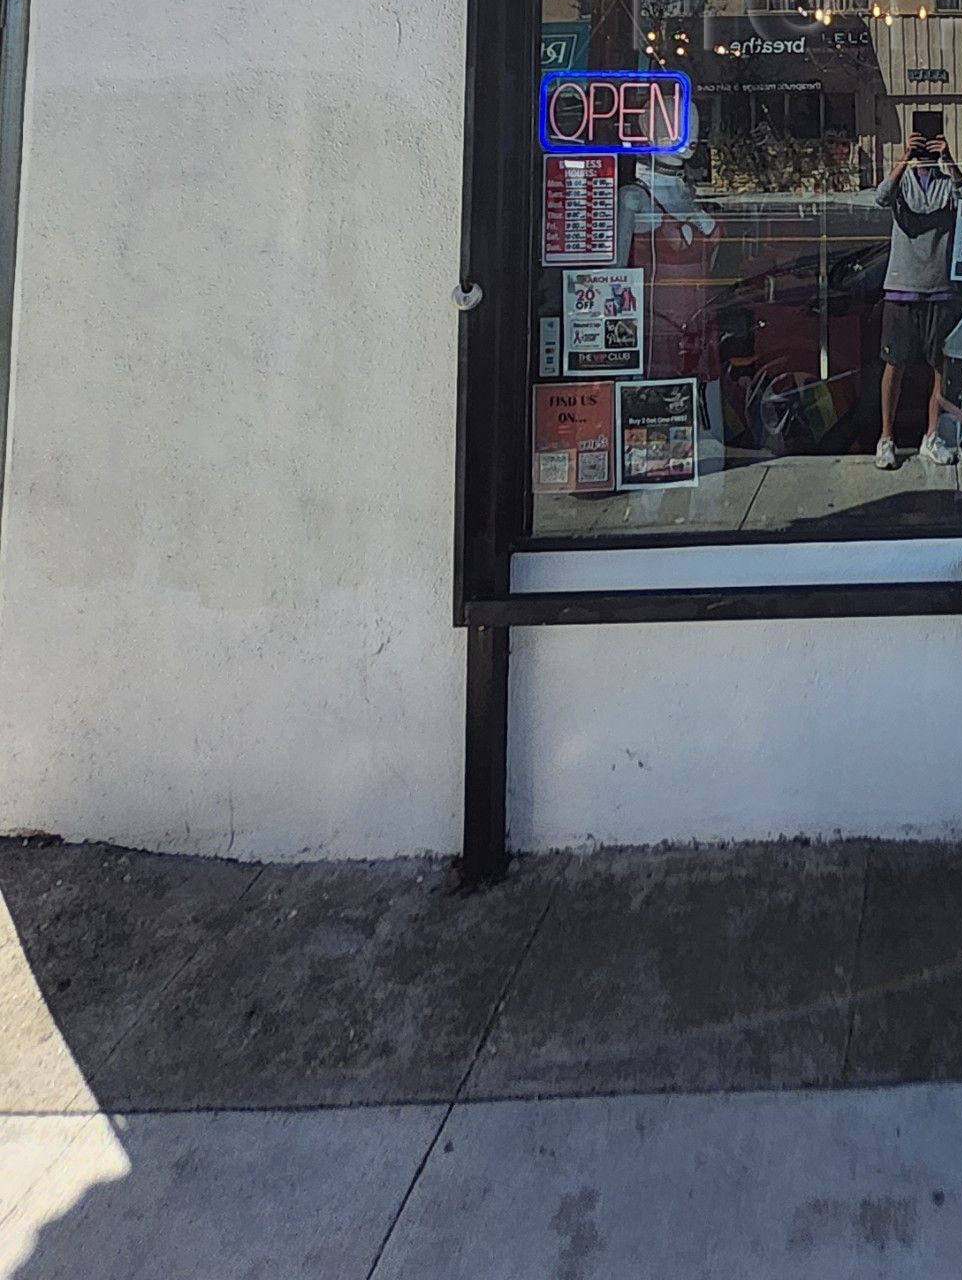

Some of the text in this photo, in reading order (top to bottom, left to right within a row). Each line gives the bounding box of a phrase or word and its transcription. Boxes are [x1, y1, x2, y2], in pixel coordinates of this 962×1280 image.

[549, 82, 680, 142] OPEN
[576, 302, 595, 310] OFF
[578, 353, 592, 361] THE
[608, 352, 630, 361] CLUB
[549, 395, 597, 407] FIND US
